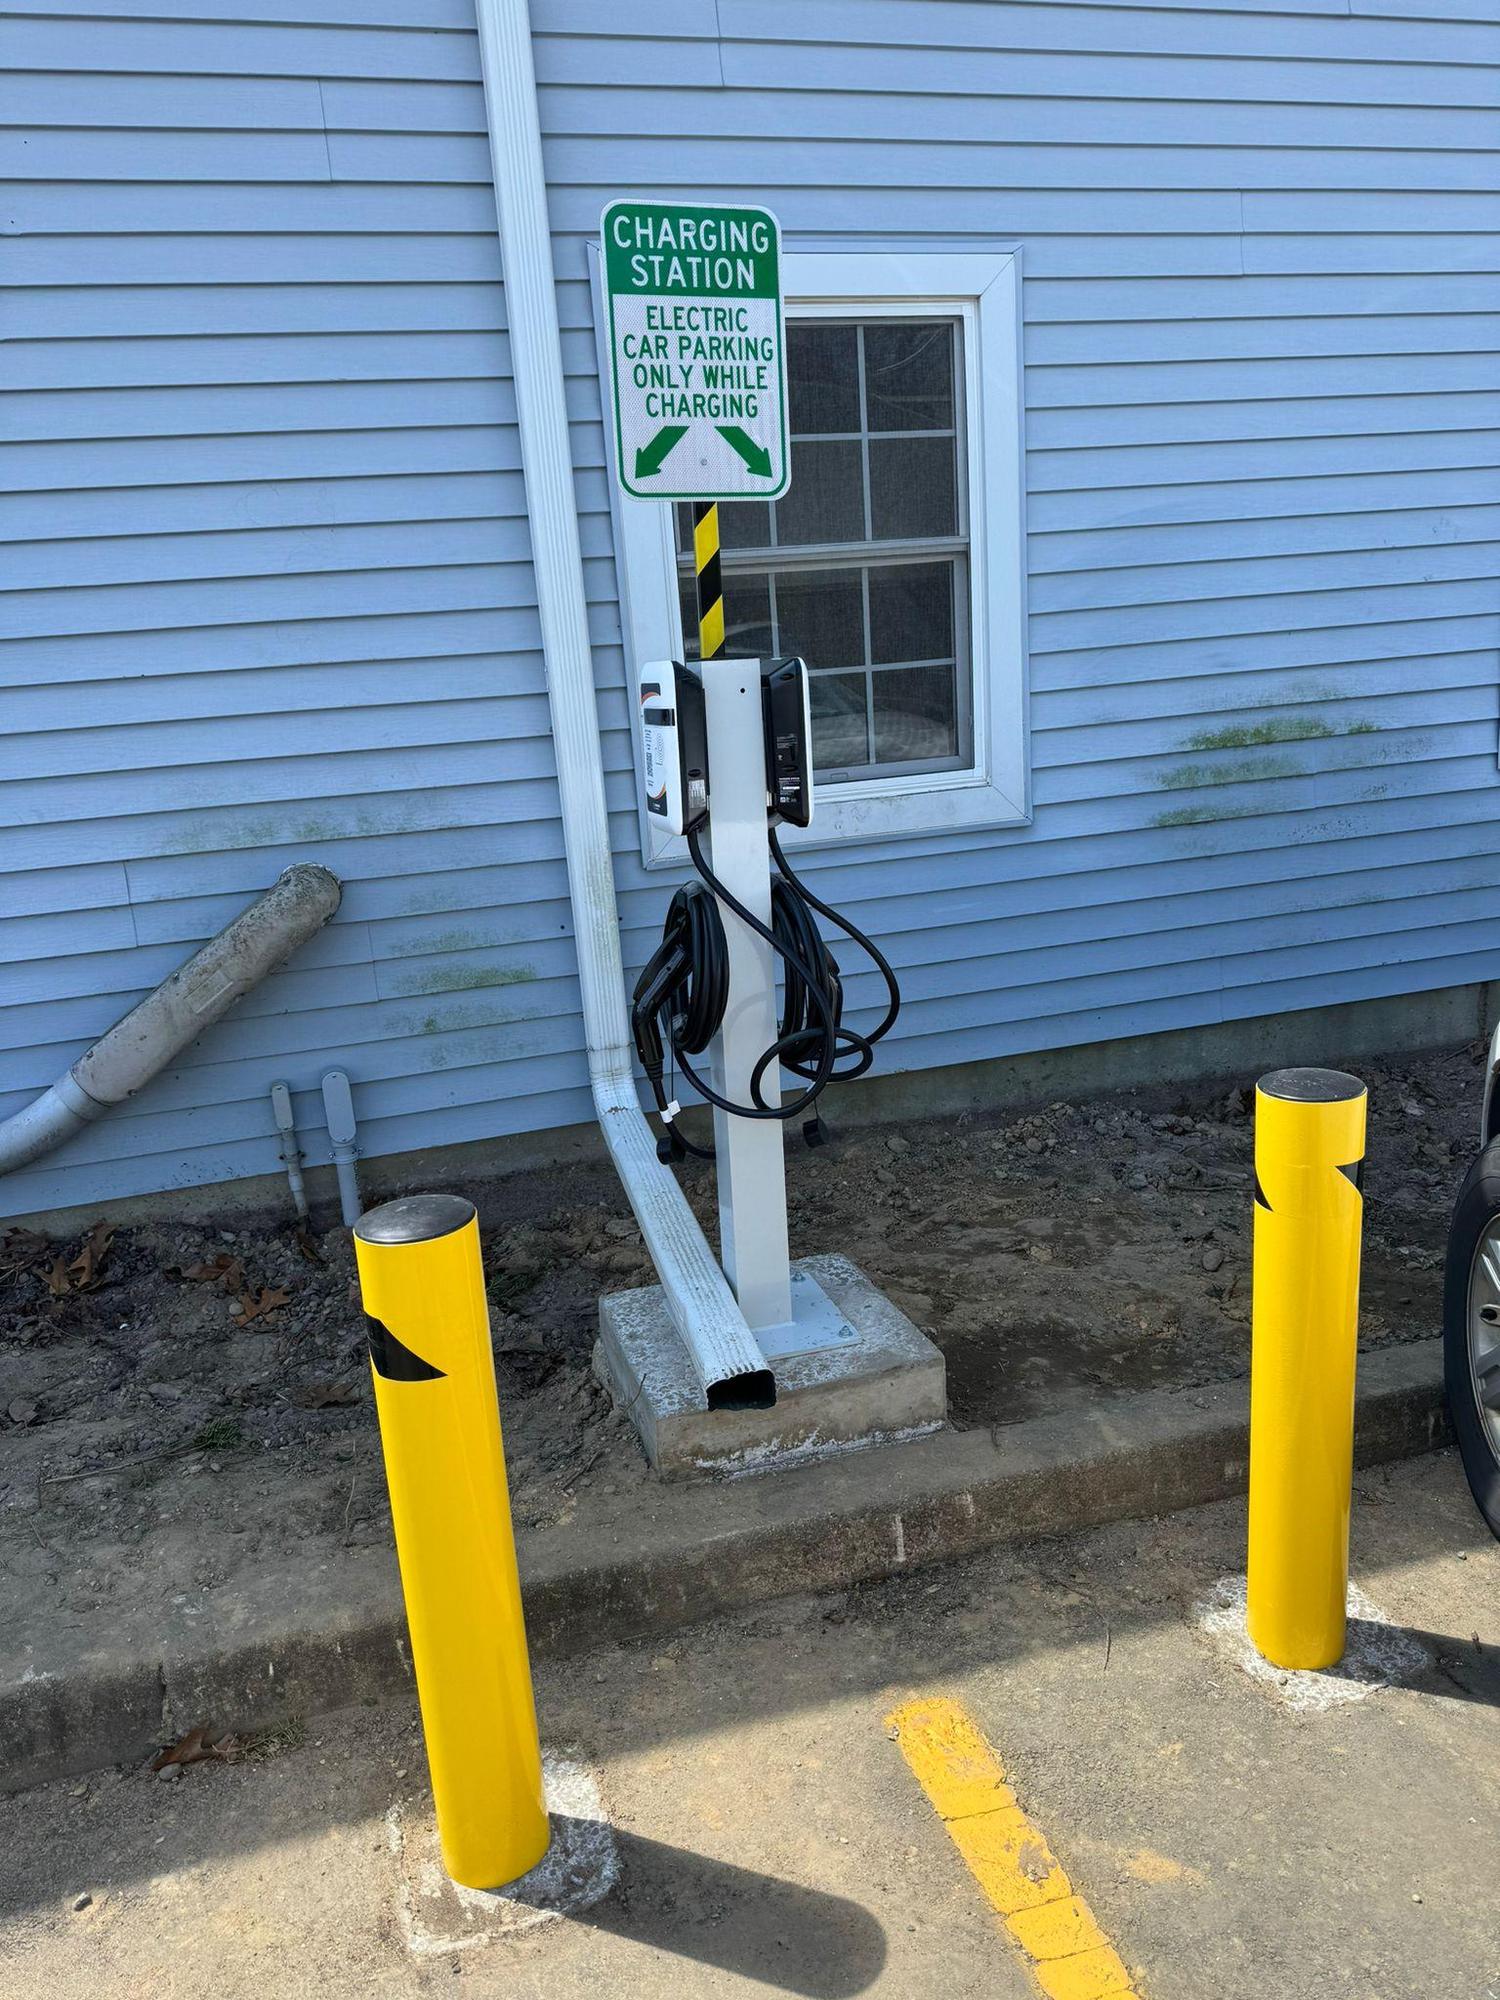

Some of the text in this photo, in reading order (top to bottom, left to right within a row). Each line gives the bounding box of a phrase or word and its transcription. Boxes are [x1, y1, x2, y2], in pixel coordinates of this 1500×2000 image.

[613, 215, 769, 254] CHARGING
[631, 255, 755, 289] STATION
[646, 305, 748, 332] ELECTRIC
[623, 334, 774, 361] CAR PARKING
[633, 363, 768, 390] ONLY WHILE
[646, 393, 758, 418] CHARGING
